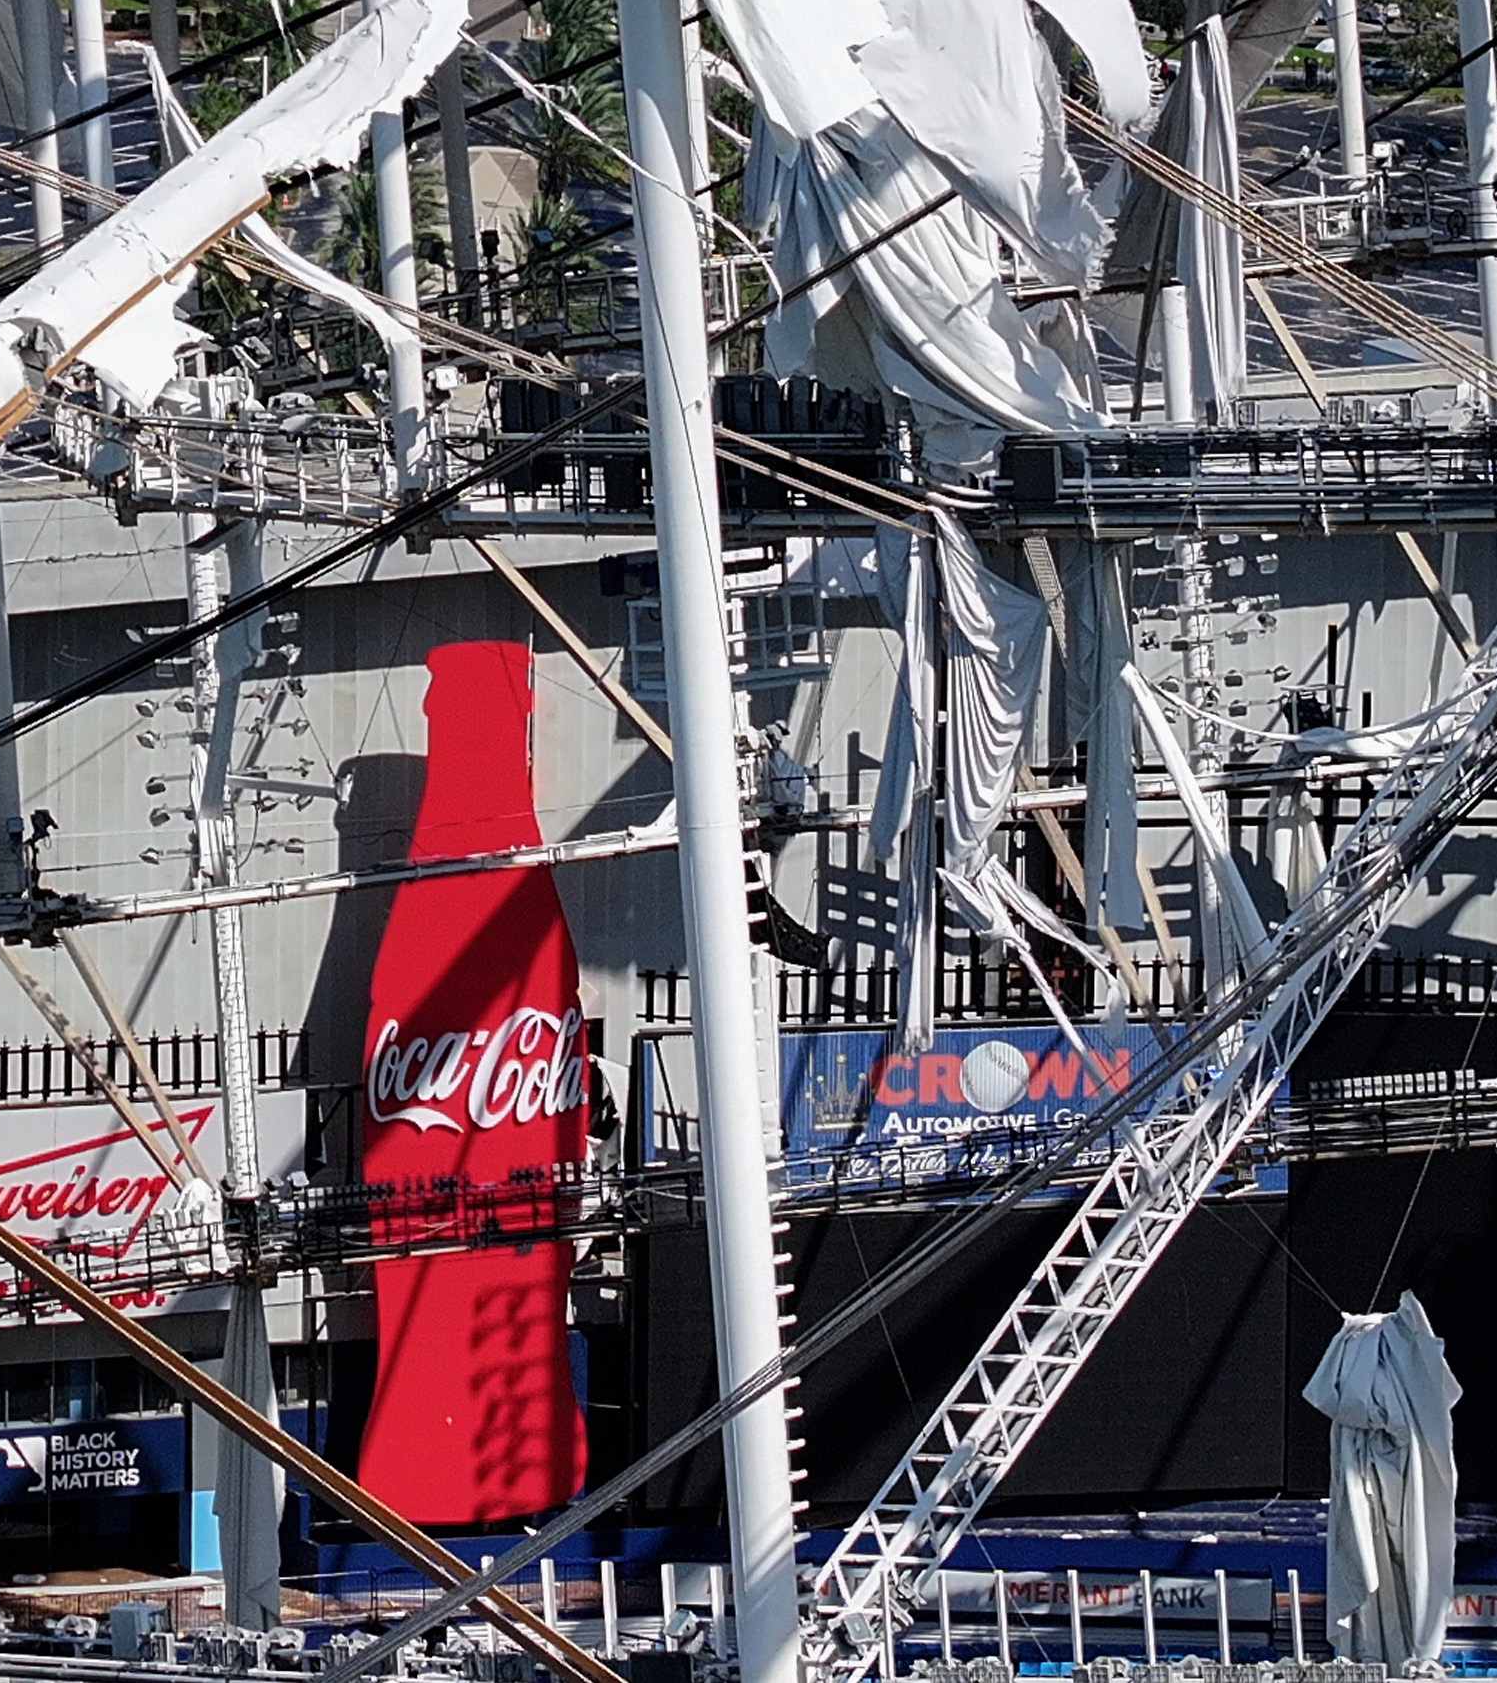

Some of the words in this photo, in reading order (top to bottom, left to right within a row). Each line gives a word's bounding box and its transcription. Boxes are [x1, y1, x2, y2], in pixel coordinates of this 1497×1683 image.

[369, 1007, 588, 1133] Coca-Cola
[51, 1432, 117, 1453] BLACK
[52, 1448, 140, 1471] HISTORY
[52, 1468, 141, 1491] MATTERS
